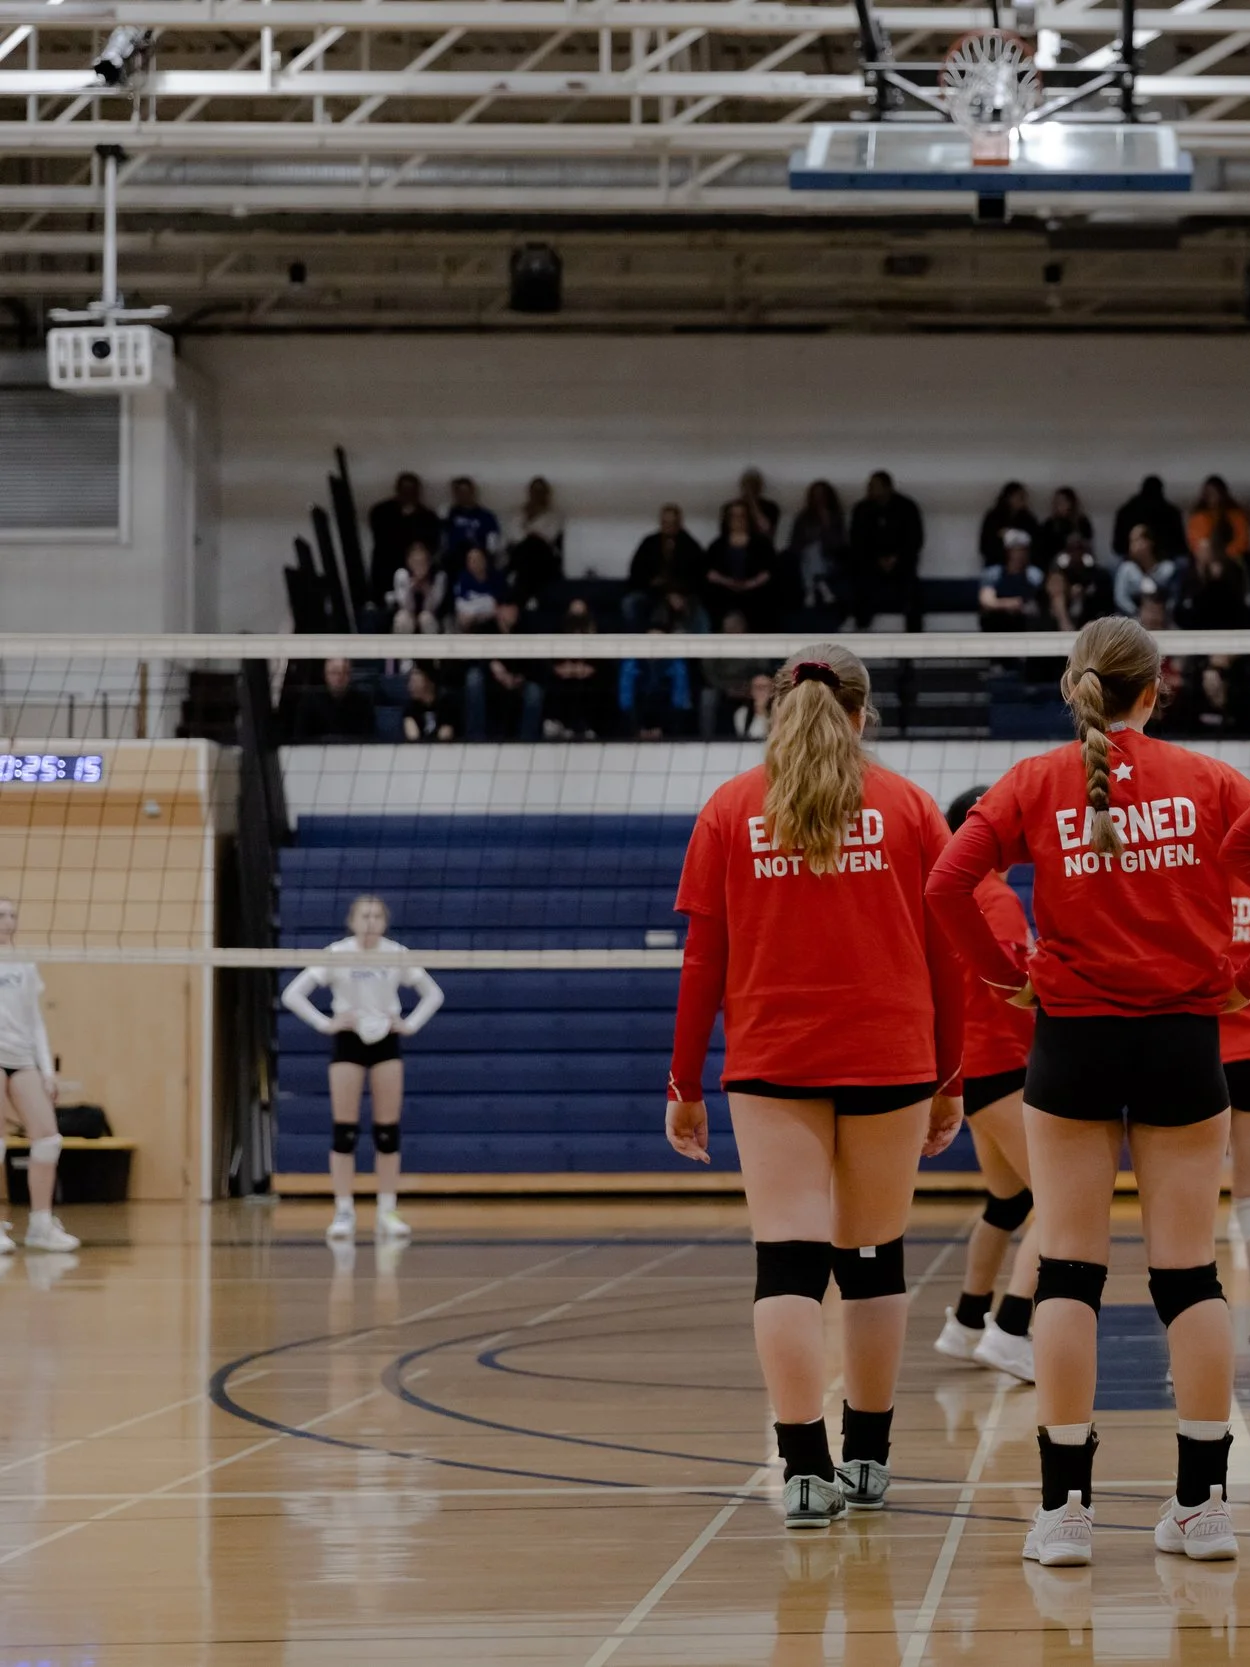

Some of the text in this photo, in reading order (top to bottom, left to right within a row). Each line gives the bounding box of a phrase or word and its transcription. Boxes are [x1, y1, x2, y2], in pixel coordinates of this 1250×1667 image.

[748, 808, 884, 853] EED
[753, 855, 803, 879] NOT
[1063, 843, 1201, 878] NOT GIVEN.
